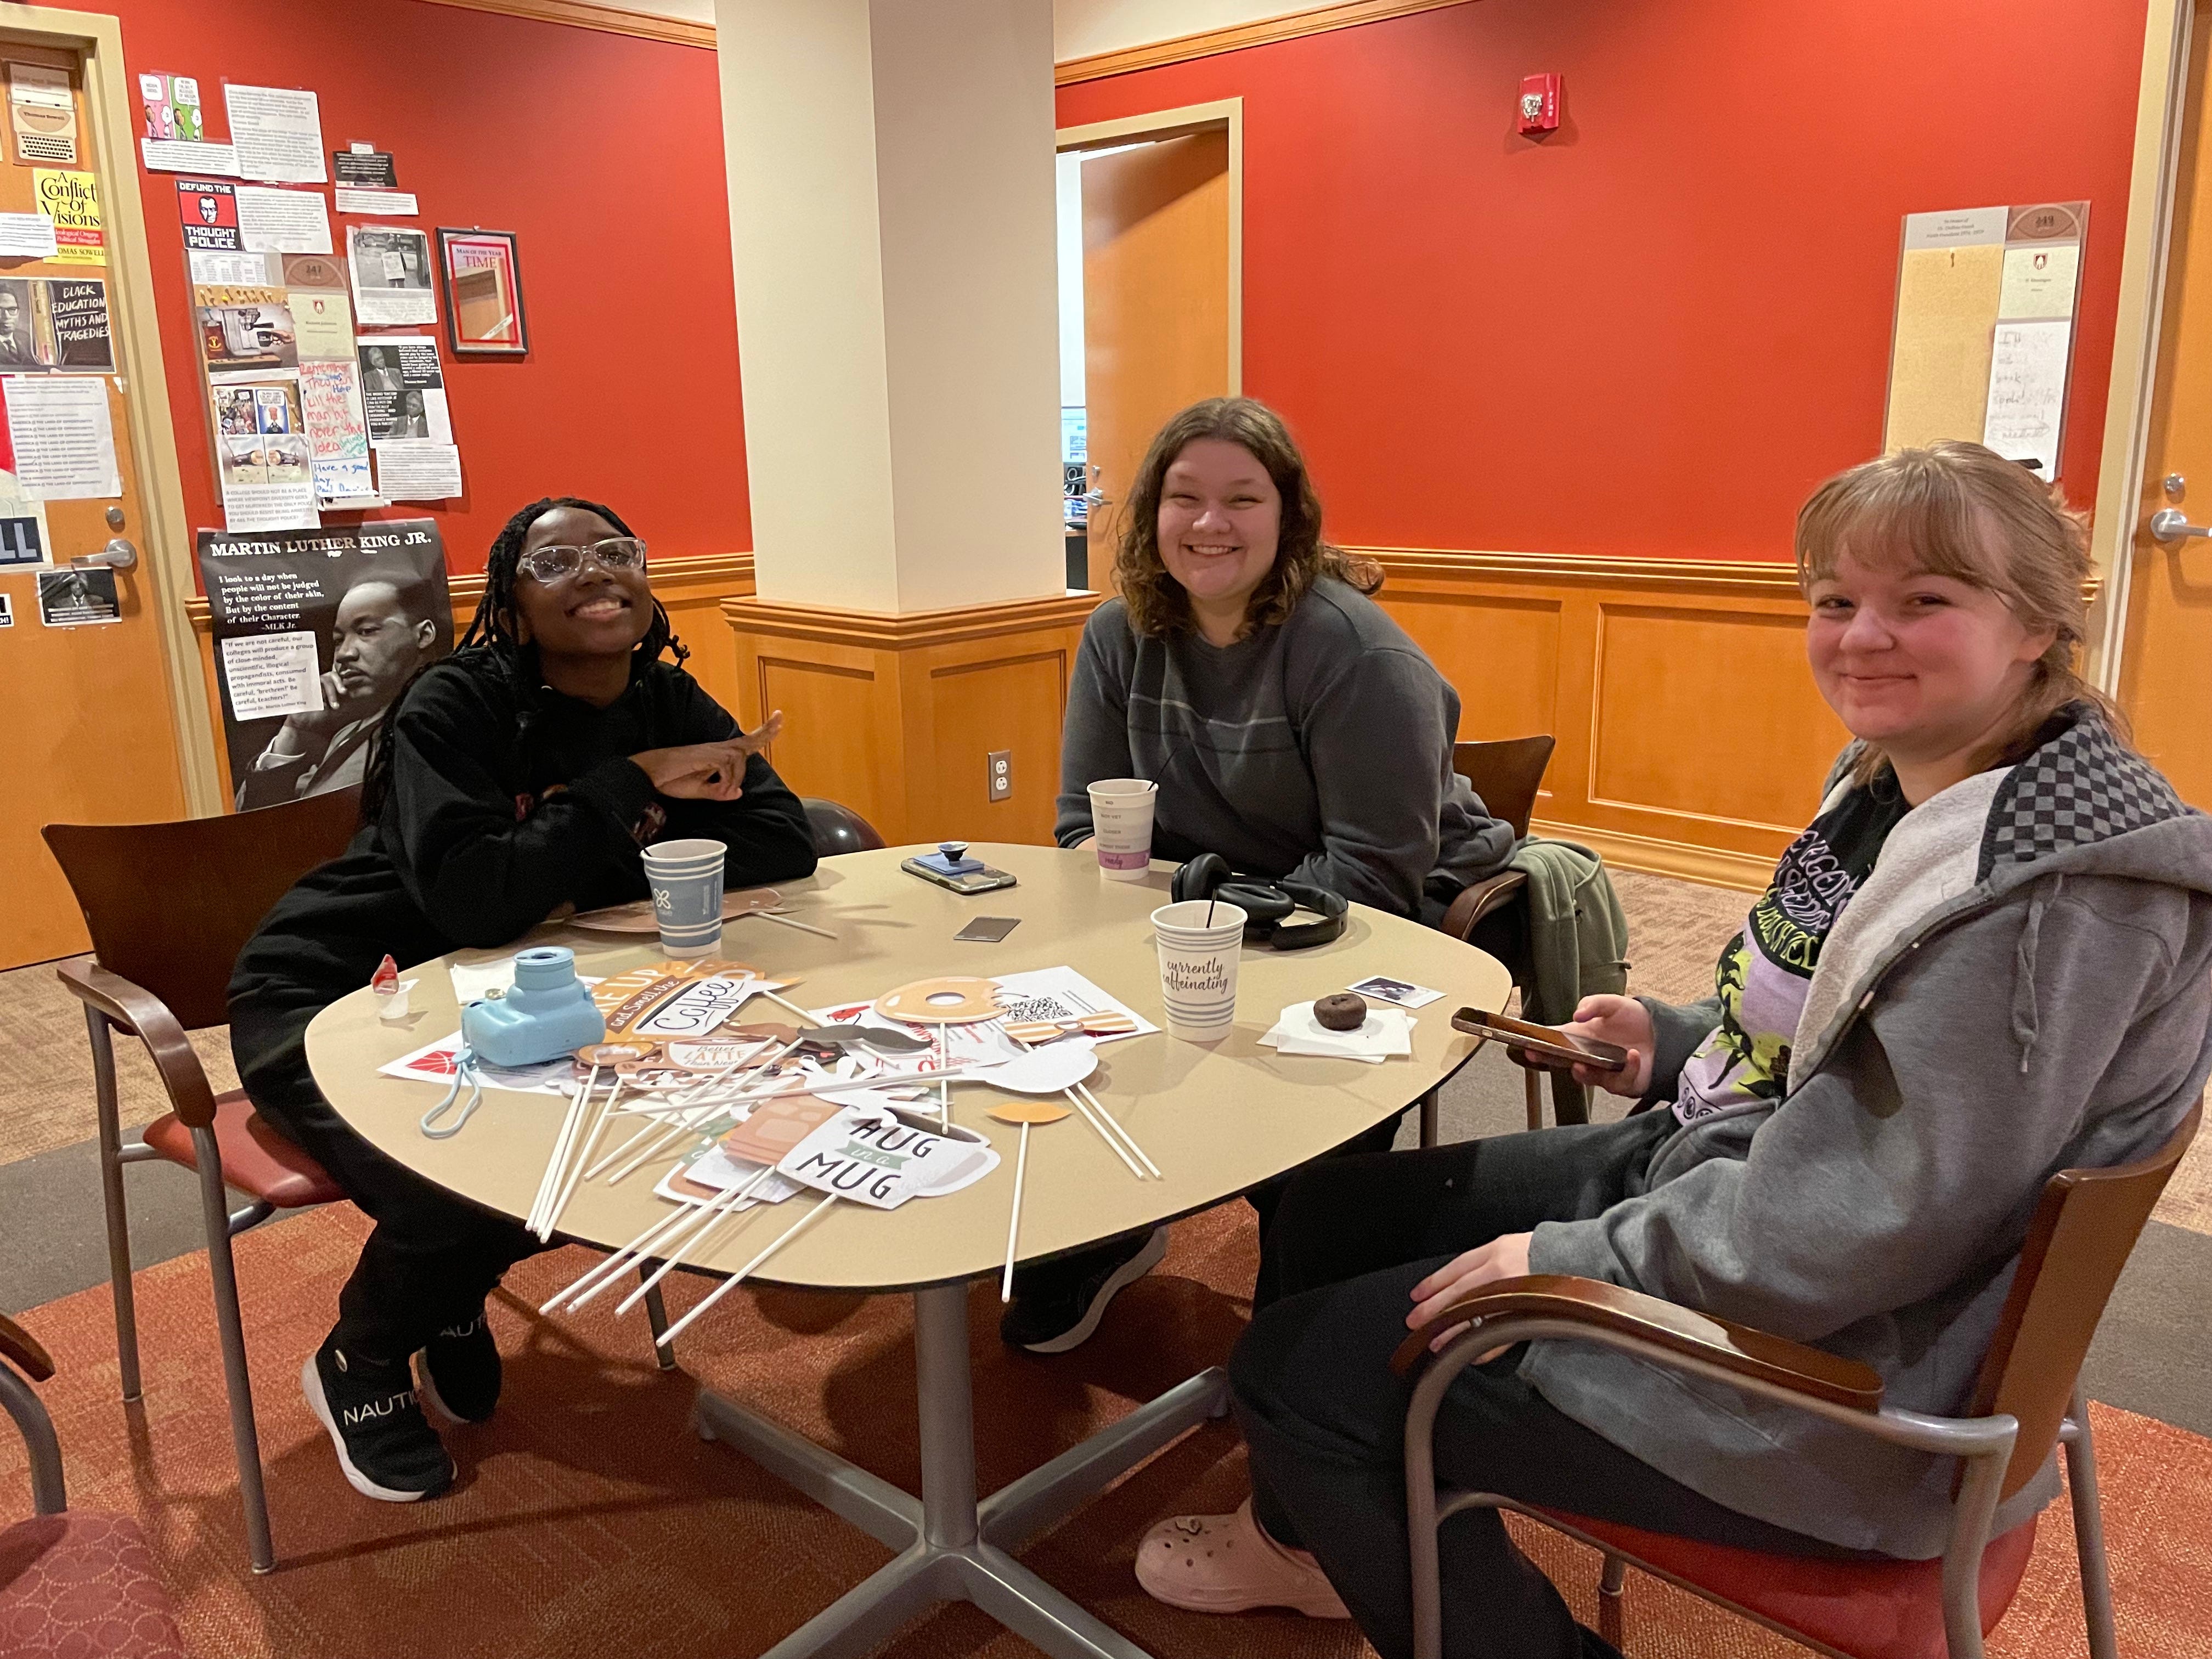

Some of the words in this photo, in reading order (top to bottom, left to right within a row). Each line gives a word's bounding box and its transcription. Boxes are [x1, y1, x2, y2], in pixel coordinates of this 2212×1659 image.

[58, 172, 68, 183] A
[41, 178, 97, 205] Conflict
[179, 183, 213, 191] DEFUND
[40, 200, 100, 227] Visions
[70, 199, 87, 215] of
[185, 226, 235, 238] THOUGHT
[189, 236, 236, 249] POLICE
[463, 256, 496, 268] TIME
[64, 284, 96, 298] BLACK
[52, 297, 105, 313] EDUCATION
[56, 316, 87, 329] MYTHS
[89, 313, 108, 325] AND
[57, 326, 110, 341] TRAGEDIES
[210, 541, 281, 556] MARTIN
[285, 537, 357, 552] LUTHER
[359, 534, 400, 548] KING
[404, 531, 432, 545] JR.
[262, 573, 275, 582] day
[222, 585, 248, 595] people
[293, 580, 319, 591] judged
[223, 596, 233, 605] by
[242, 606, 251, 614] by
[239, 615, 259, 623] their
[1167, 957, 1222, 979] currently
[605, 969, 666, 988] UP
[1163, 971, 1228, 994] caffeinating
[611, 1013, 631, 1027] and
[623, 991, 655, 1012] Smell
[654, 980, 680, 995] the
[654, 981, 739, 1030] Coffee
[849, 1118, 940, 1158] HUG
[851, 1148, 873, 1160] in
[876, 1156, 890, 1165] a
[795, 1152, 901, 1199] MUG
